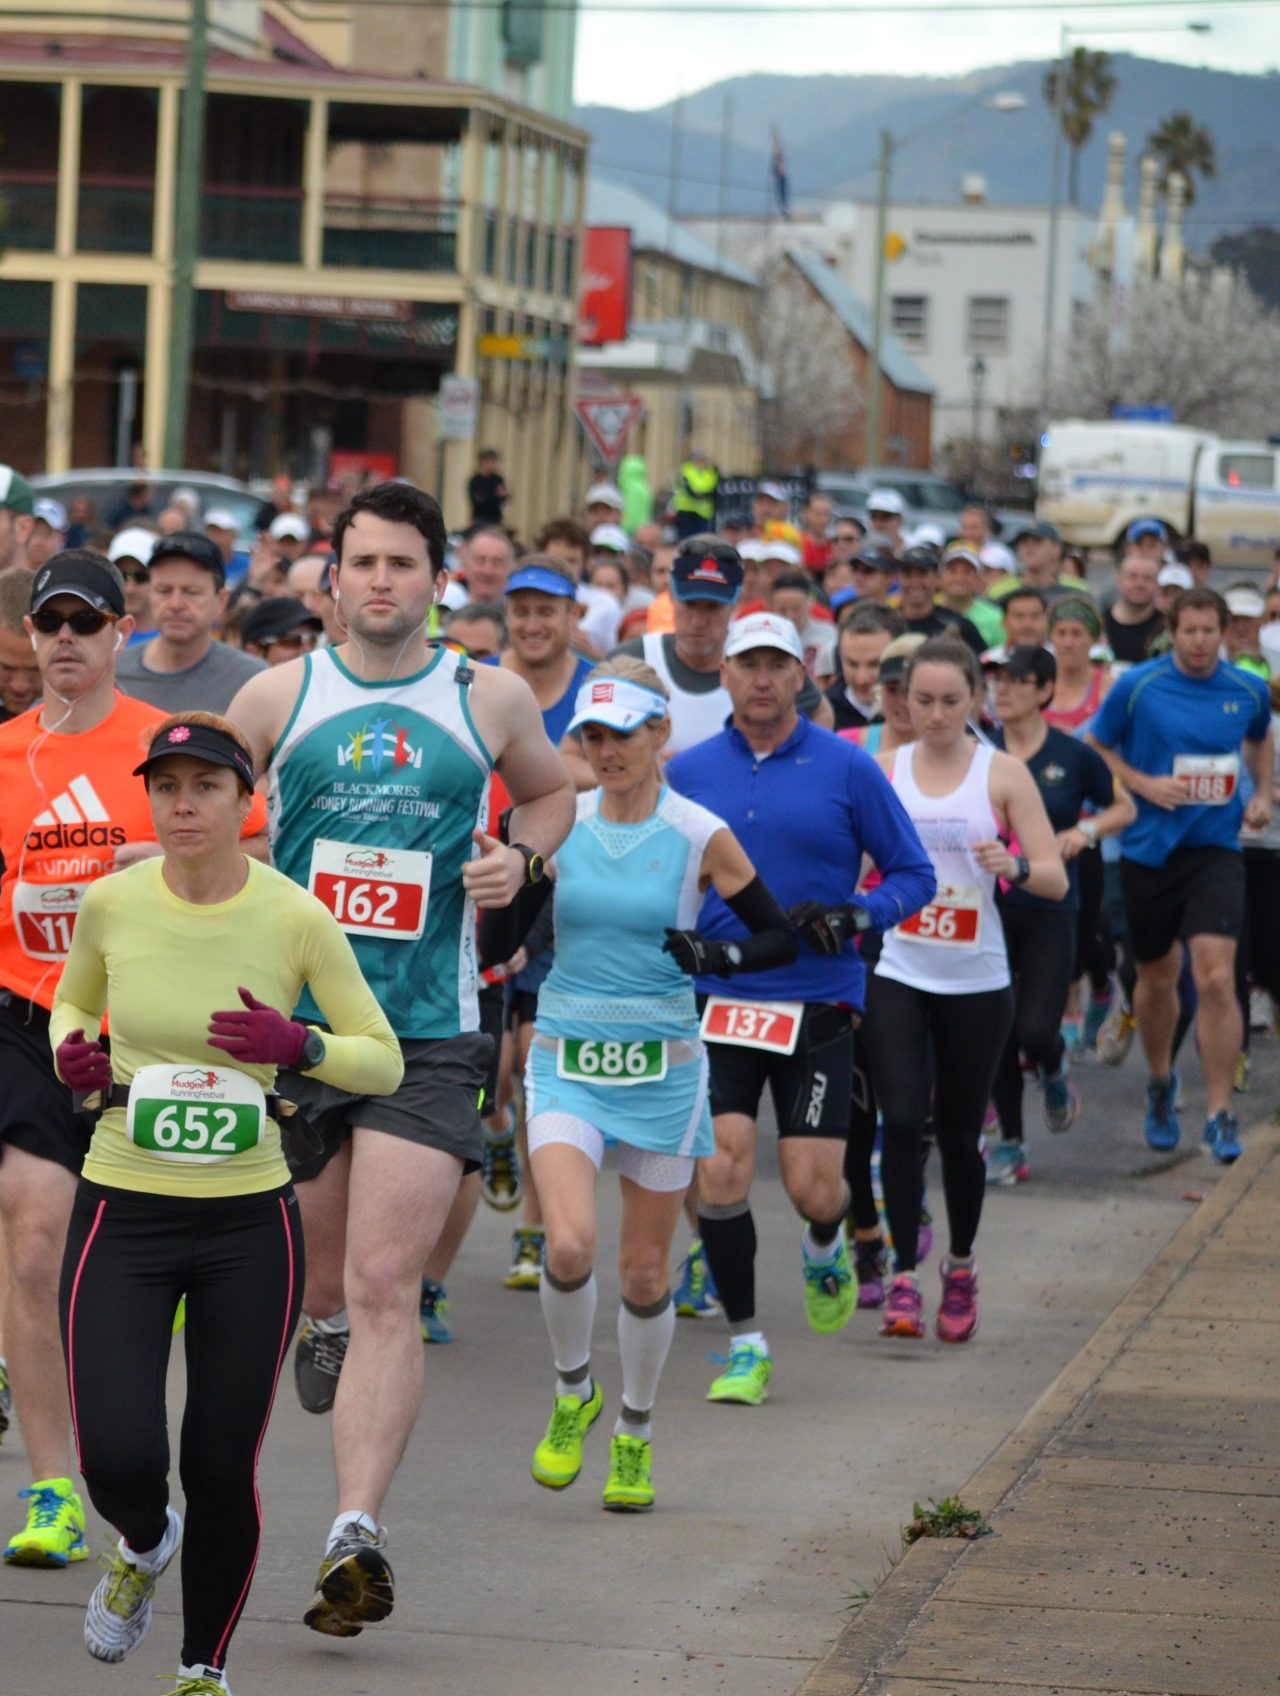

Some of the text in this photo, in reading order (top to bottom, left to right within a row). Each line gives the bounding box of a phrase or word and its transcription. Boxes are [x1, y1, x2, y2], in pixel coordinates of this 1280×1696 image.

[332, 782, 421, 797] BLACKMORES
[311, 795, 347, 812] SYDNEY
[349, 797, 394, 814] RUNNING
[397, 800, 440, 819] FESTIVAL
[25, 822, 127, 851] adidas
[332, 880, 398, 926] 162
[40, 916, 71, 951] 11
[918, 905, 958, 939] 56
[726, 1006, 778, 1041] 137
[578, 1040, 648, 1076] 686
[170, 1088, 225, 1100] RunningFestival
[171, 1080, 206, 1091] Mudgee
[153, 1105, 238, 1152] 652
